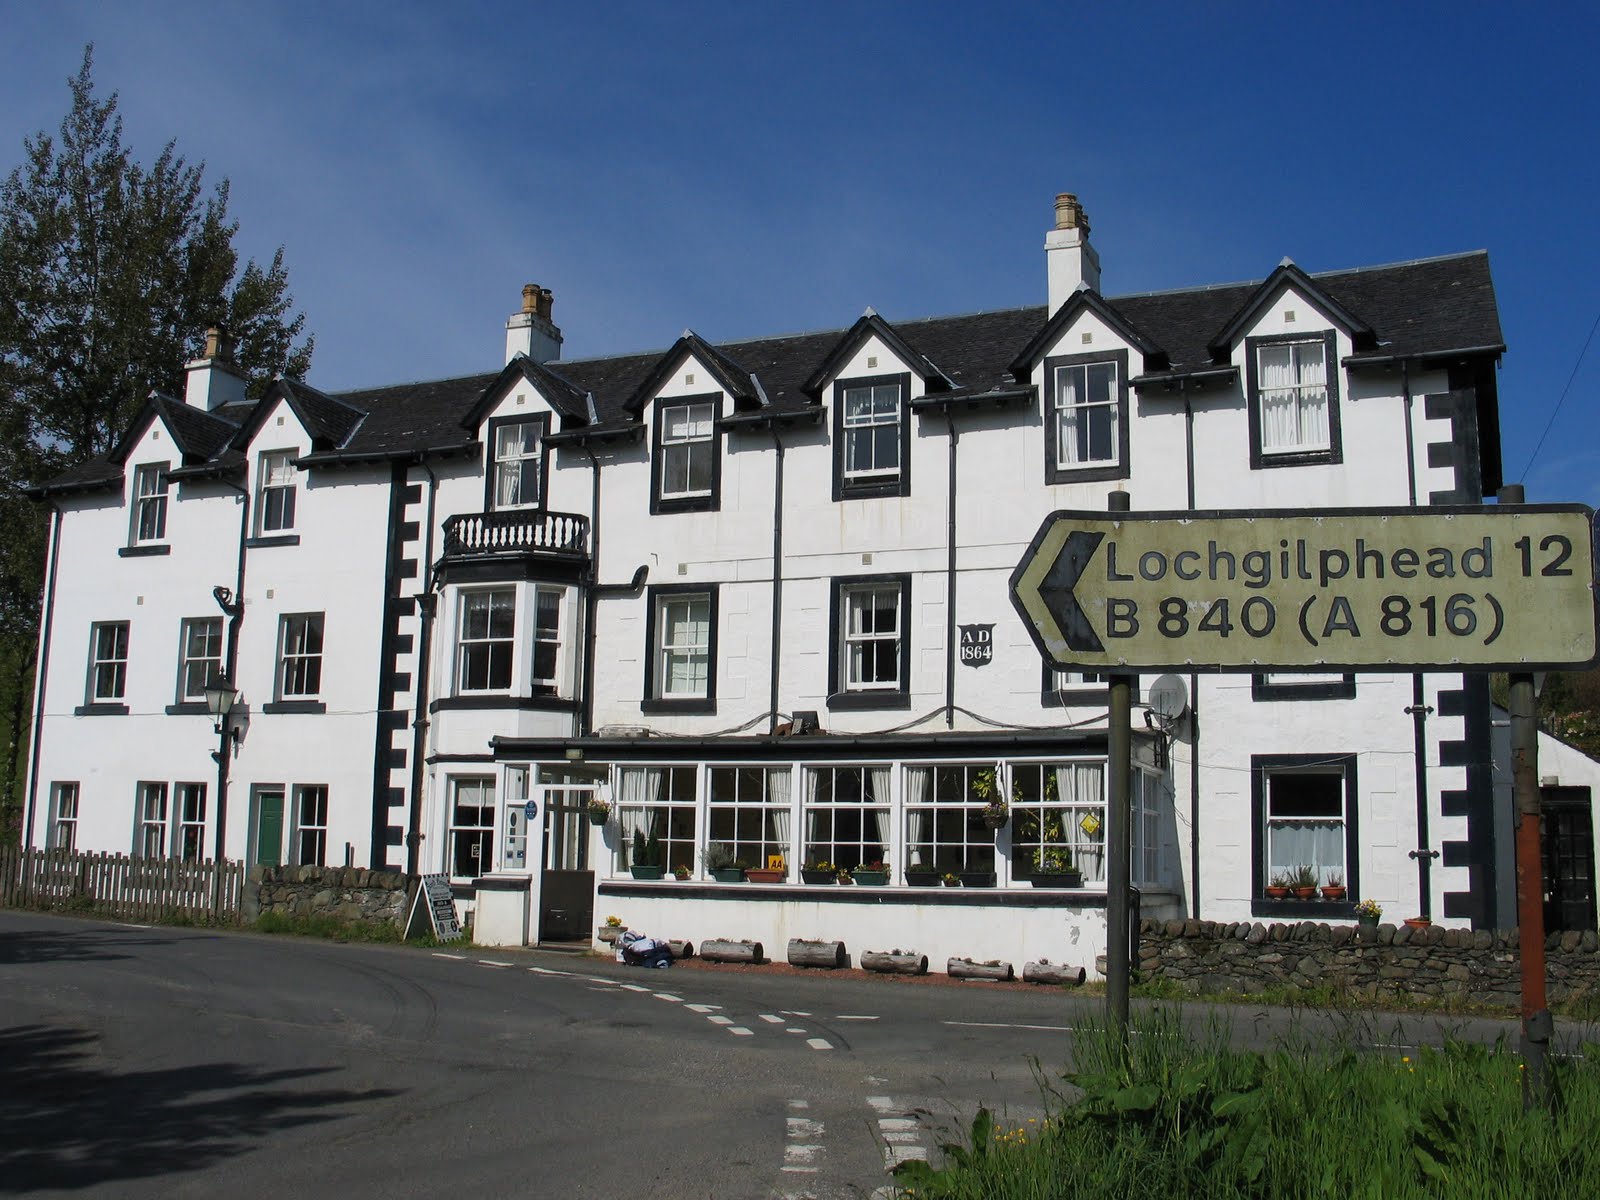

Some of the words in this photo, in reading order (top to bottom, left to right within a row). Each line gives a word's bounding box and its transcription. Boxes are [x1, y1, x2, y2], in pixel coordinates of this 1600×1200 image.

[1107, 536, 1493, 588] Lochgilphead
[1515, 535, 1573, 576] 12
[1106, 597, 1140, 638] B
[1157, 595, 1277, 638] 840
[1299, 594, 1361, 647] (A
[1380, 593, 1504, 646] 816)
[961, 645, 992, 660] 1864
[771, 860, 782, 869] AA
